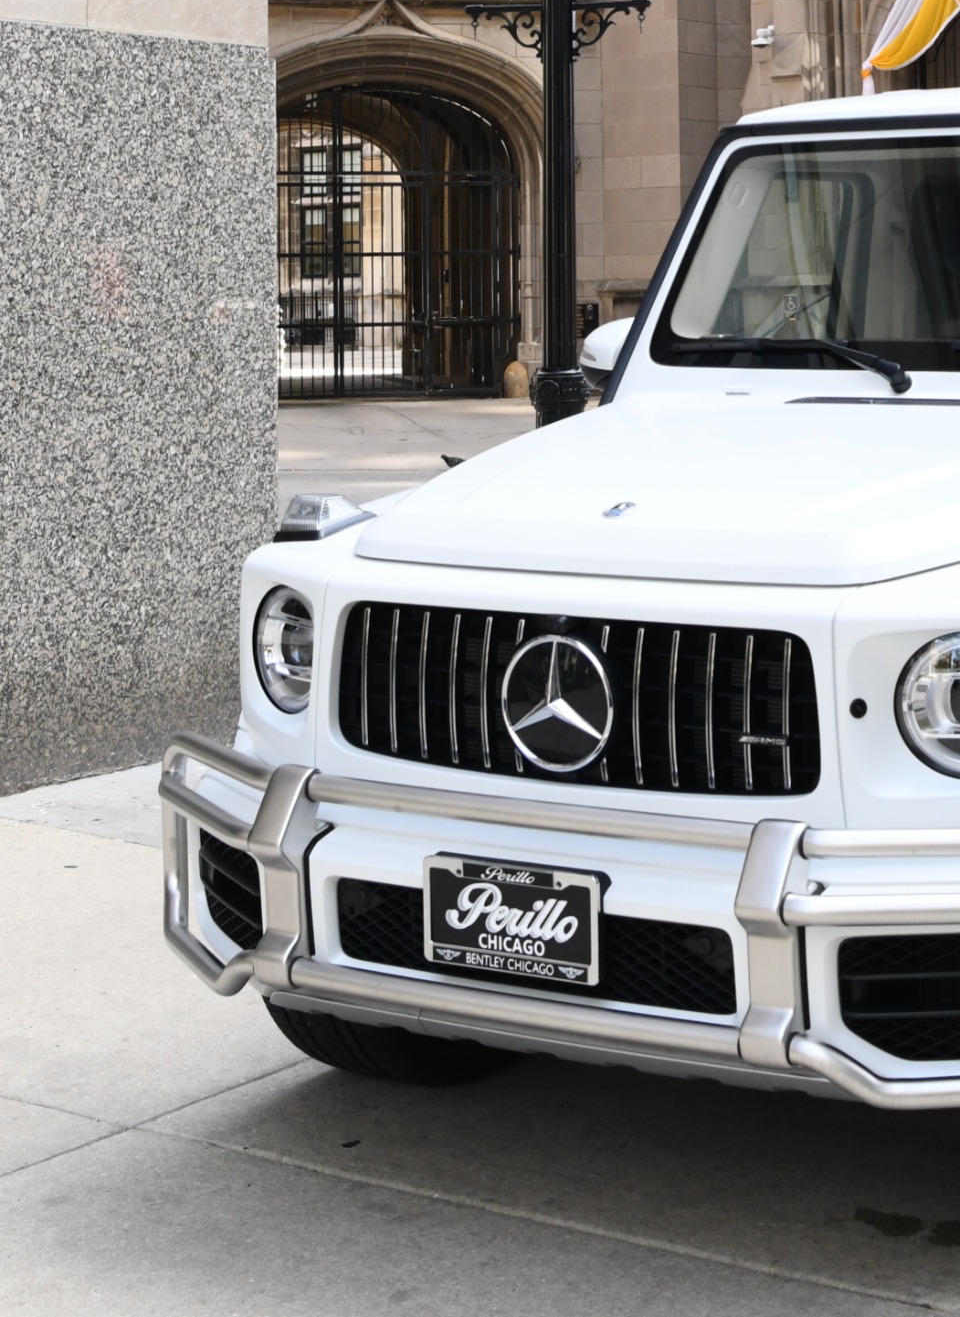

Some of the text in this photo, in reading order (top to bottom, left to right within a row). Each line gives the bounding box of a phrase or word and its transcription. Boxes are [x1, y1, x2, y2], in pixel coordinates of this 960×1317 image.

[480, 866, 535, 884] Perillo
[445, 883, 579, 944] Perillo
[478, 933, 545, 957] CHICAGO
[465, 951, 555, 976] BENTLEY CHICAGO
